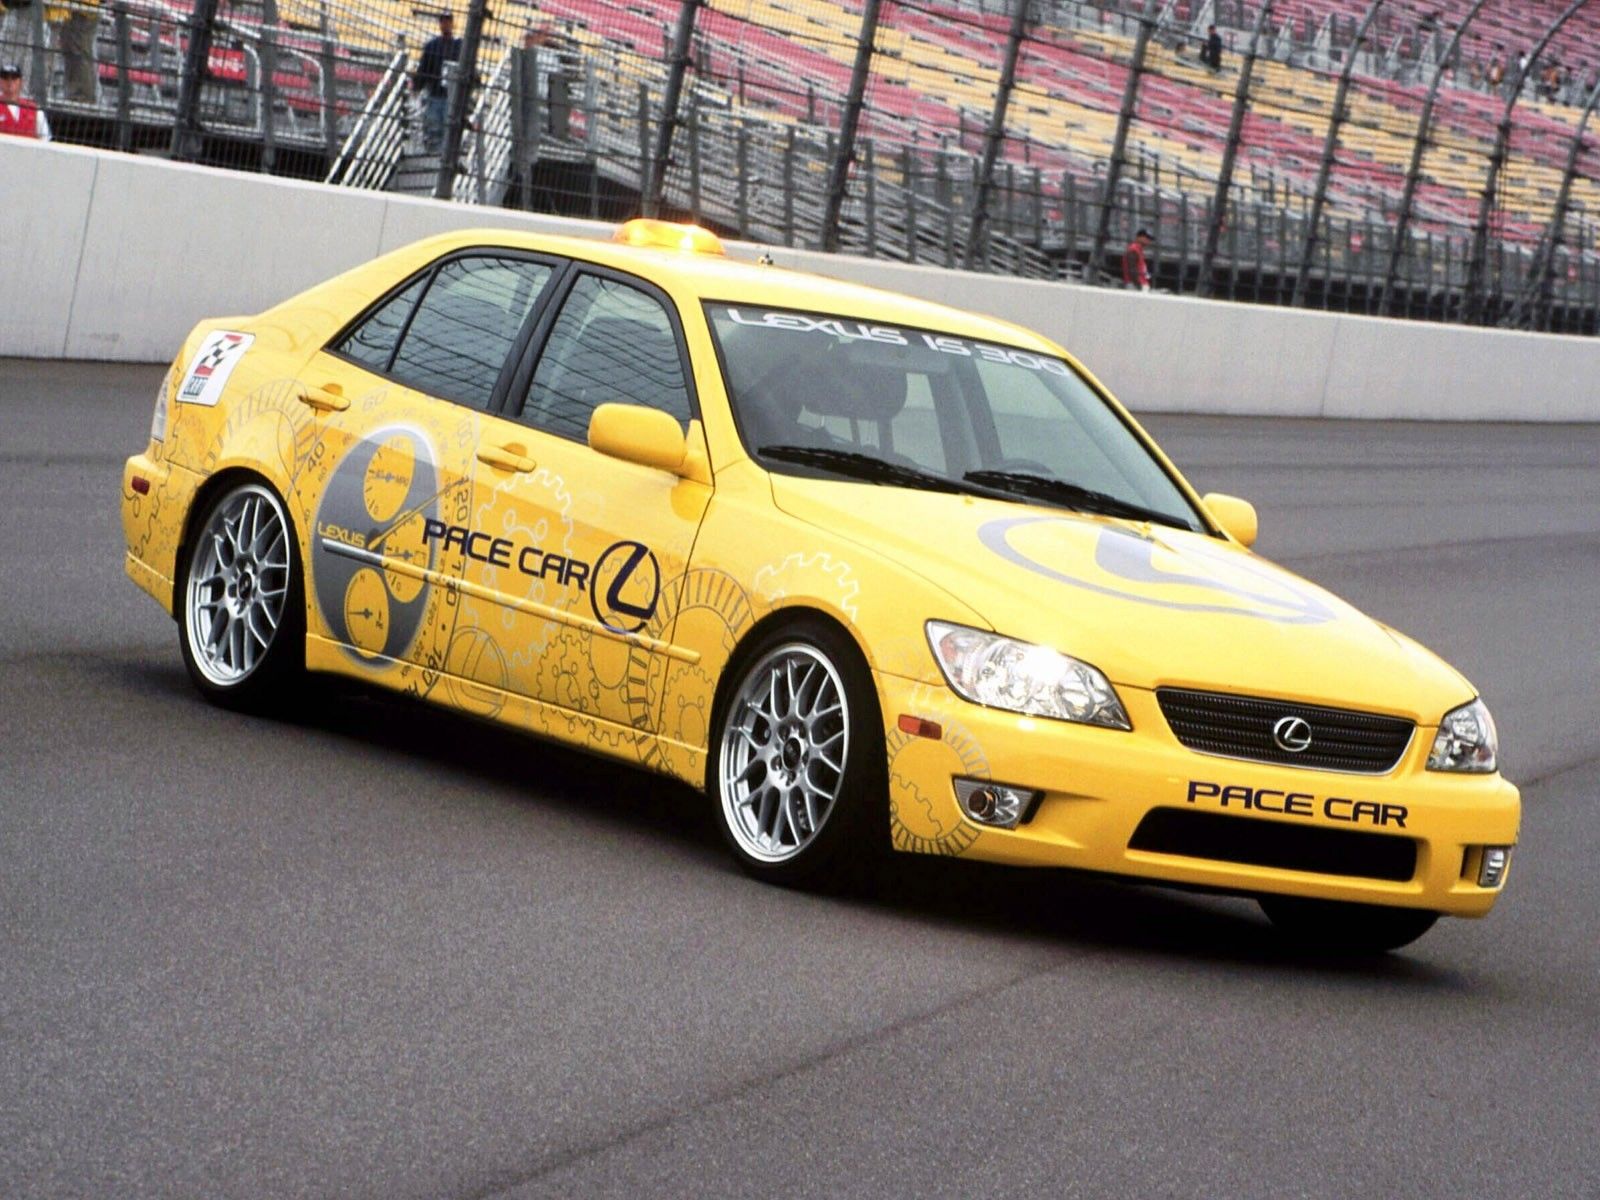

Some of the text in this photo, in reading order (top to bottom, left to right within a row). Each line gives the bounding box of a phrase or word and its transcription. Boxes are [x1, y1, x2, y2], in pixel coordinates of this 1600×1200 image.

[728, 308, 1072, 377] LEXUS IS 300
[306, 441, 325, 473] 40
[317, 521, 366, 548] LEXUS
[422, 518, 590, 591] PACE CAR
[1187, 780, 1409, 828] PACE CAR
